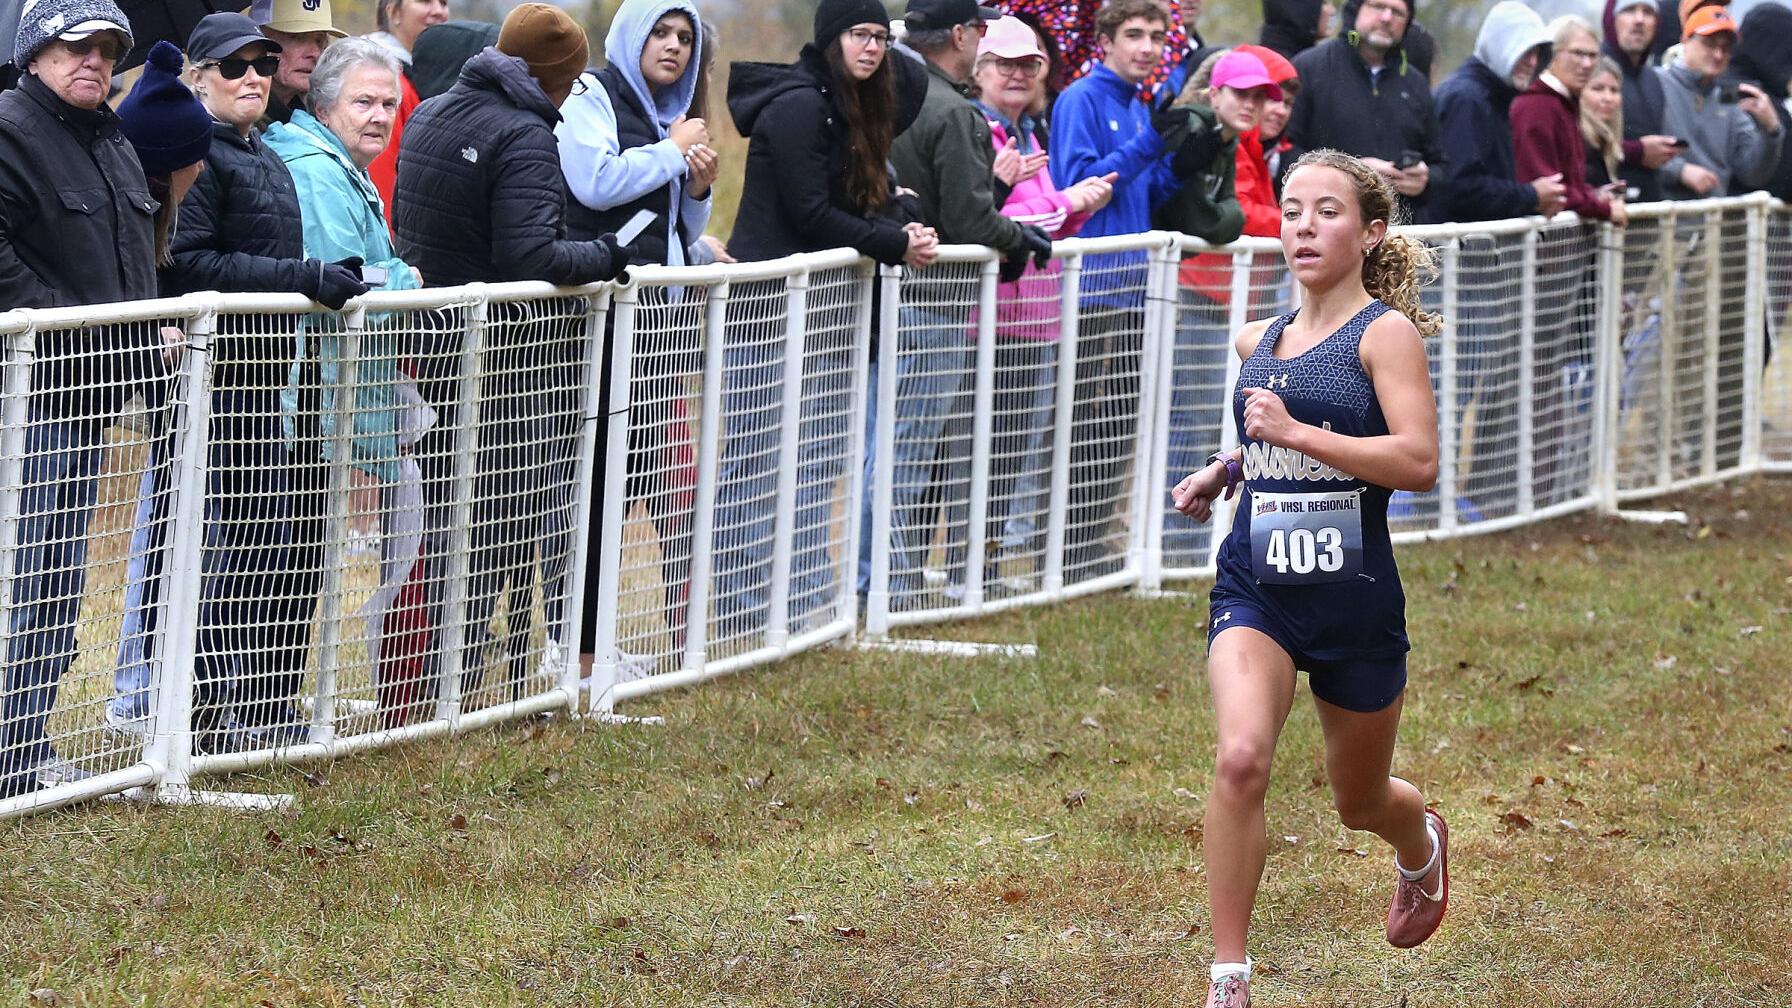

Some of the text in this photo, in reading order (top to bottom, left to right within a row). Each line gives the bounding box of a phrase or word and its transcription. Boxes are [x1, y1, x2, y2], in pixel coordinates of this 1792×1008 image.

[1281, 499, 1356, 513] VHSL REGIONAL
[1266, 527, 1344, 574] 403
